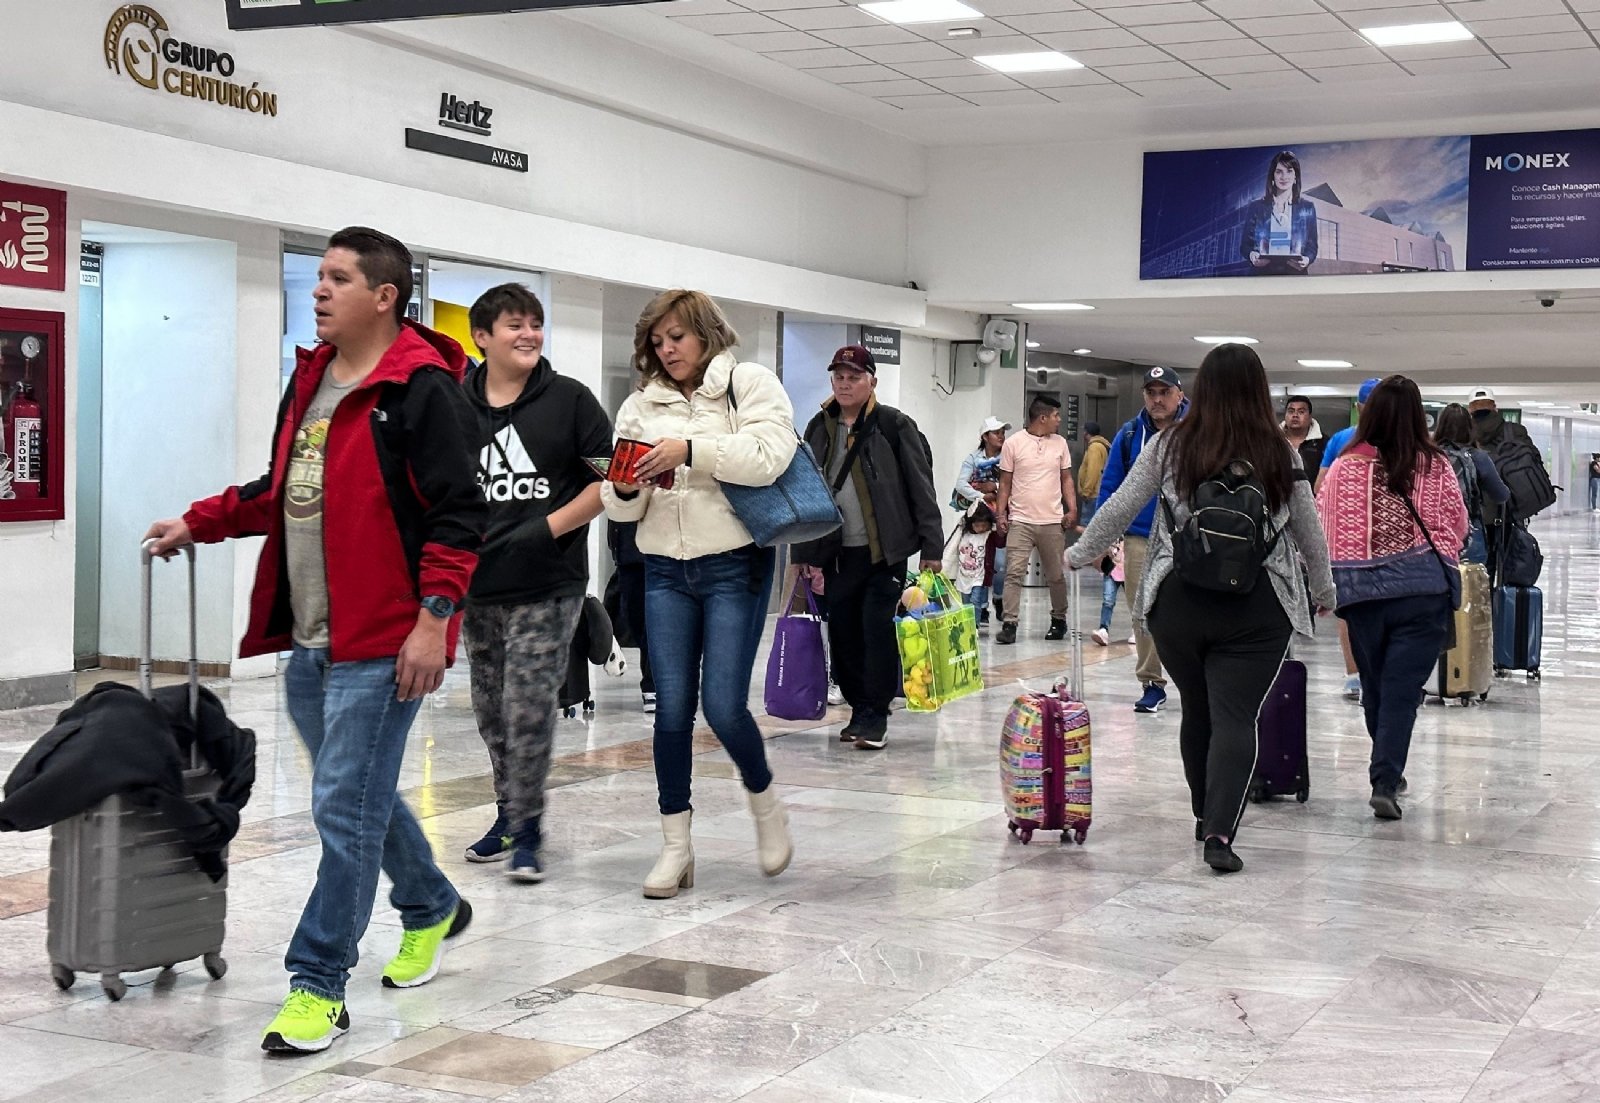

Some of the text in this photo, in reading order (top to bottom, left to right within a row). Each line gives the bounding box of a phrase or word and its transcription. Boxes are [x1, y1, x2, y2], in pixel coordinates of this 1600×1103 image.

[162, 38, 235, 77] GRUPO
[163, 67, 278, 117] CENTURIÓN
[439, 92, 493, 129] Hertz
[491, 150, 523, 169] AVASA
[1485, 152, 1570, 172] MONEX
[1511, 184, 1540, 192] Conoce
[1541, 183, 1561, 191] Cash
[1511, 193, 1523, 201] los
[1525, 215, 1565, 223] empresarios
[874, 335, 893, 344] exclusivo
[18, 431, 27, 479] PROMEX
